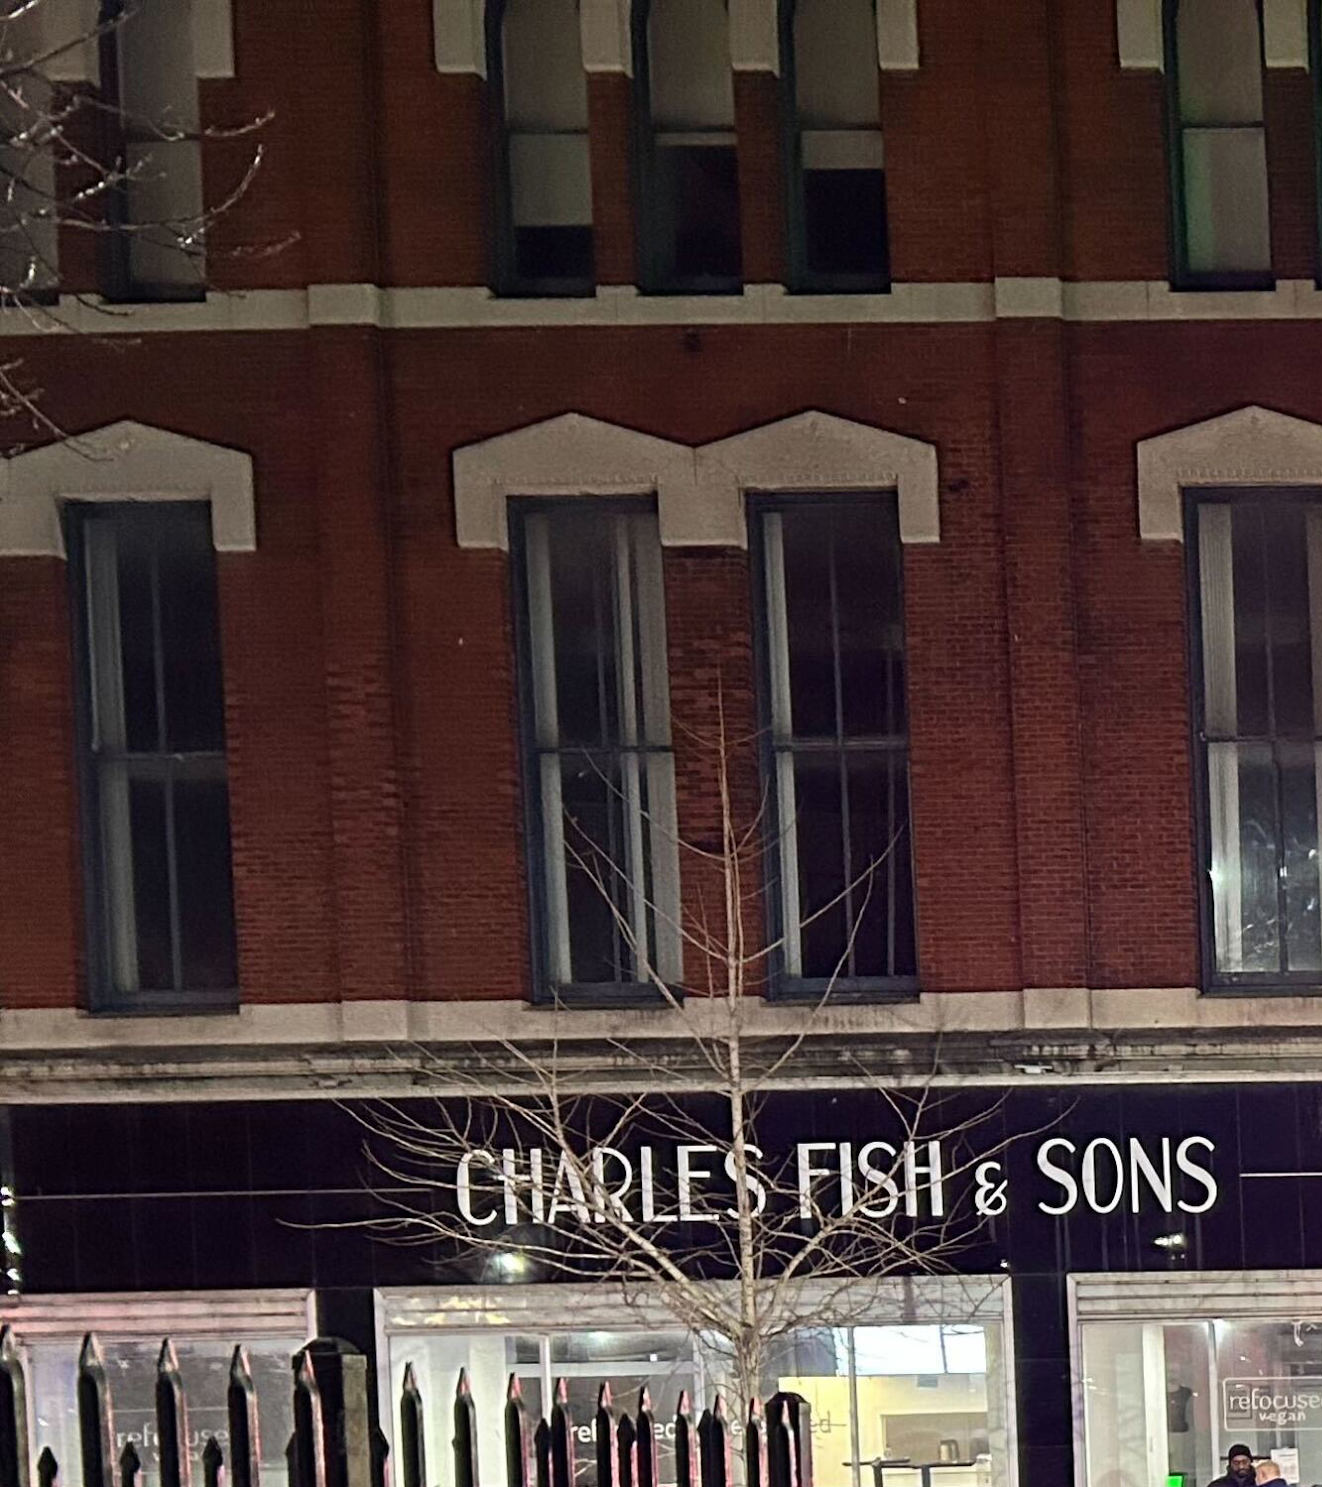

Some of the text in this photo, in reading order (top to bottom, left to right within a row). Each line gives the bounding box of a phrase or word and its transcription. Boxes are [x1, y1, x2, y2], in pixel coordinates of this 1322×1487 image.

[457, 1136, 1218, 1226] CHARLES FISH & SONS
[1260, 1412, 1305, 1425] vegan
